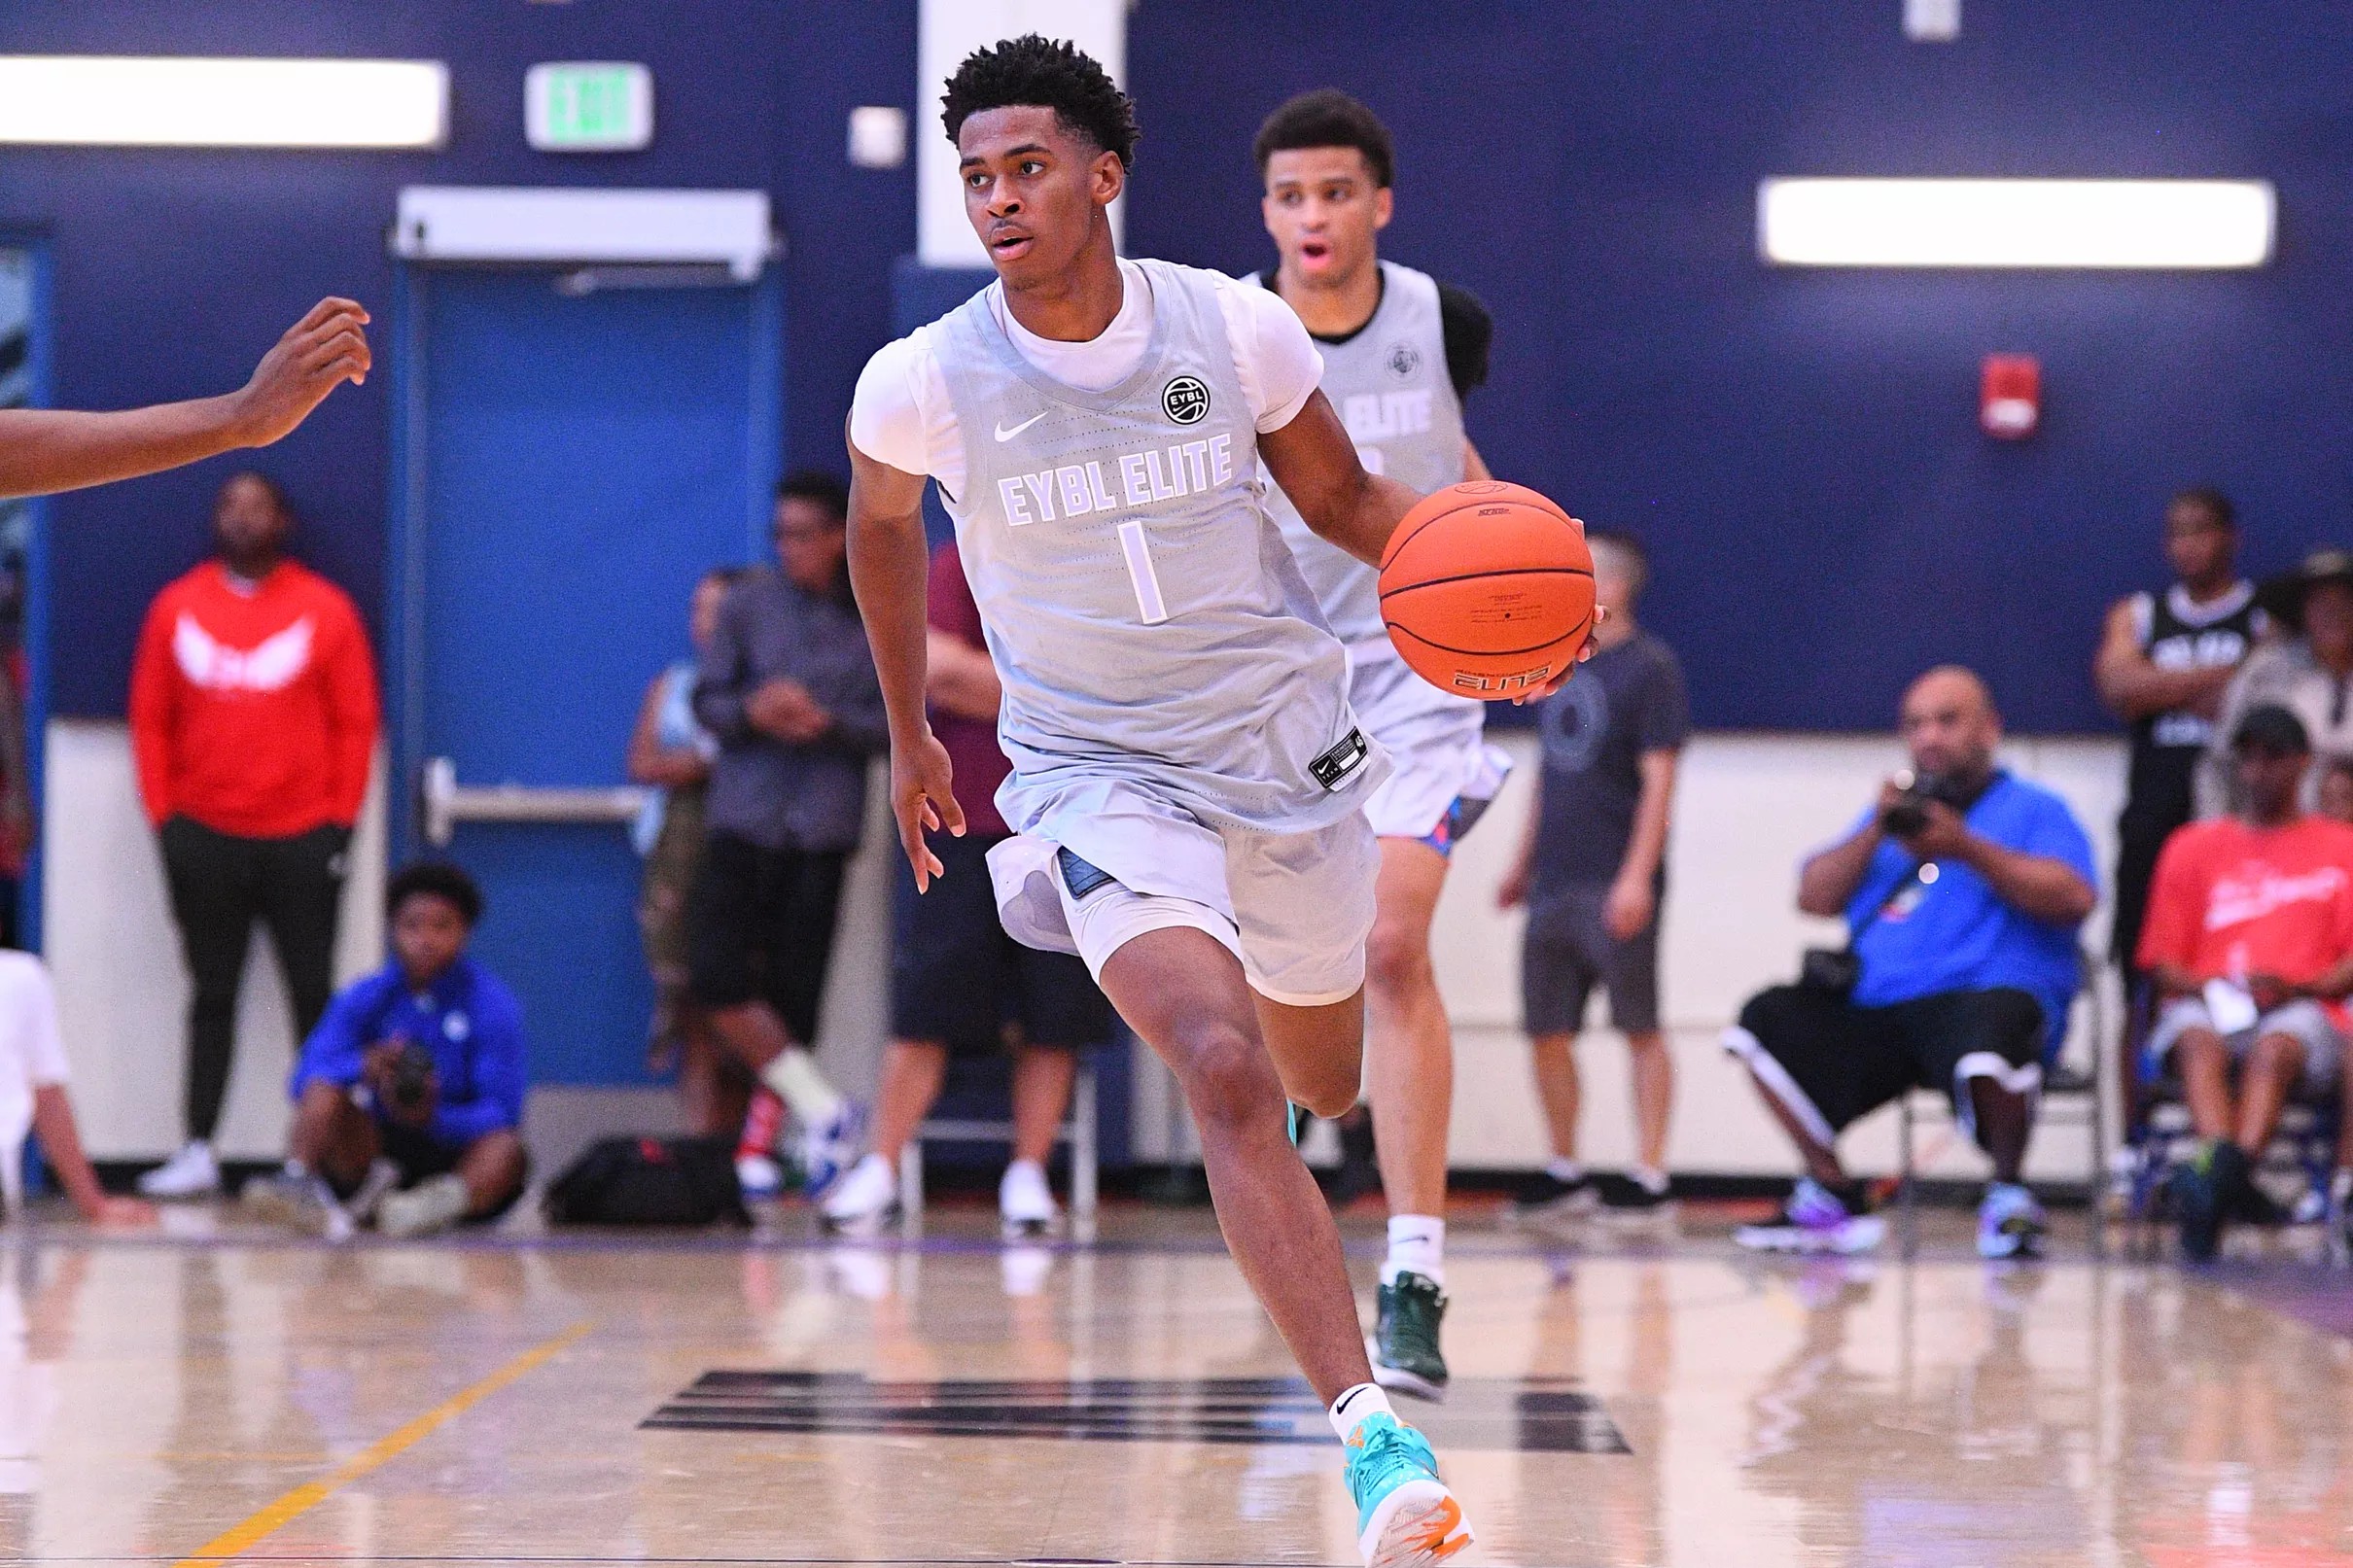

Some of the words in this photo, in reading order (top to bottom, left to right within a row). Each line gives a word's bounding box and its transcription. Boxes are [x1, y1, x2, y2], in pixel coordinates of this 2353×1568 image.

[1170, 391, 1204, 406] EYBL
[1344, 389, 1433, 442] ELITE
[998, 461, 1117, 527] EYBL
[1118, 434, 1232, 506] ELITE
[1117, 520, 1168, 625] 1
